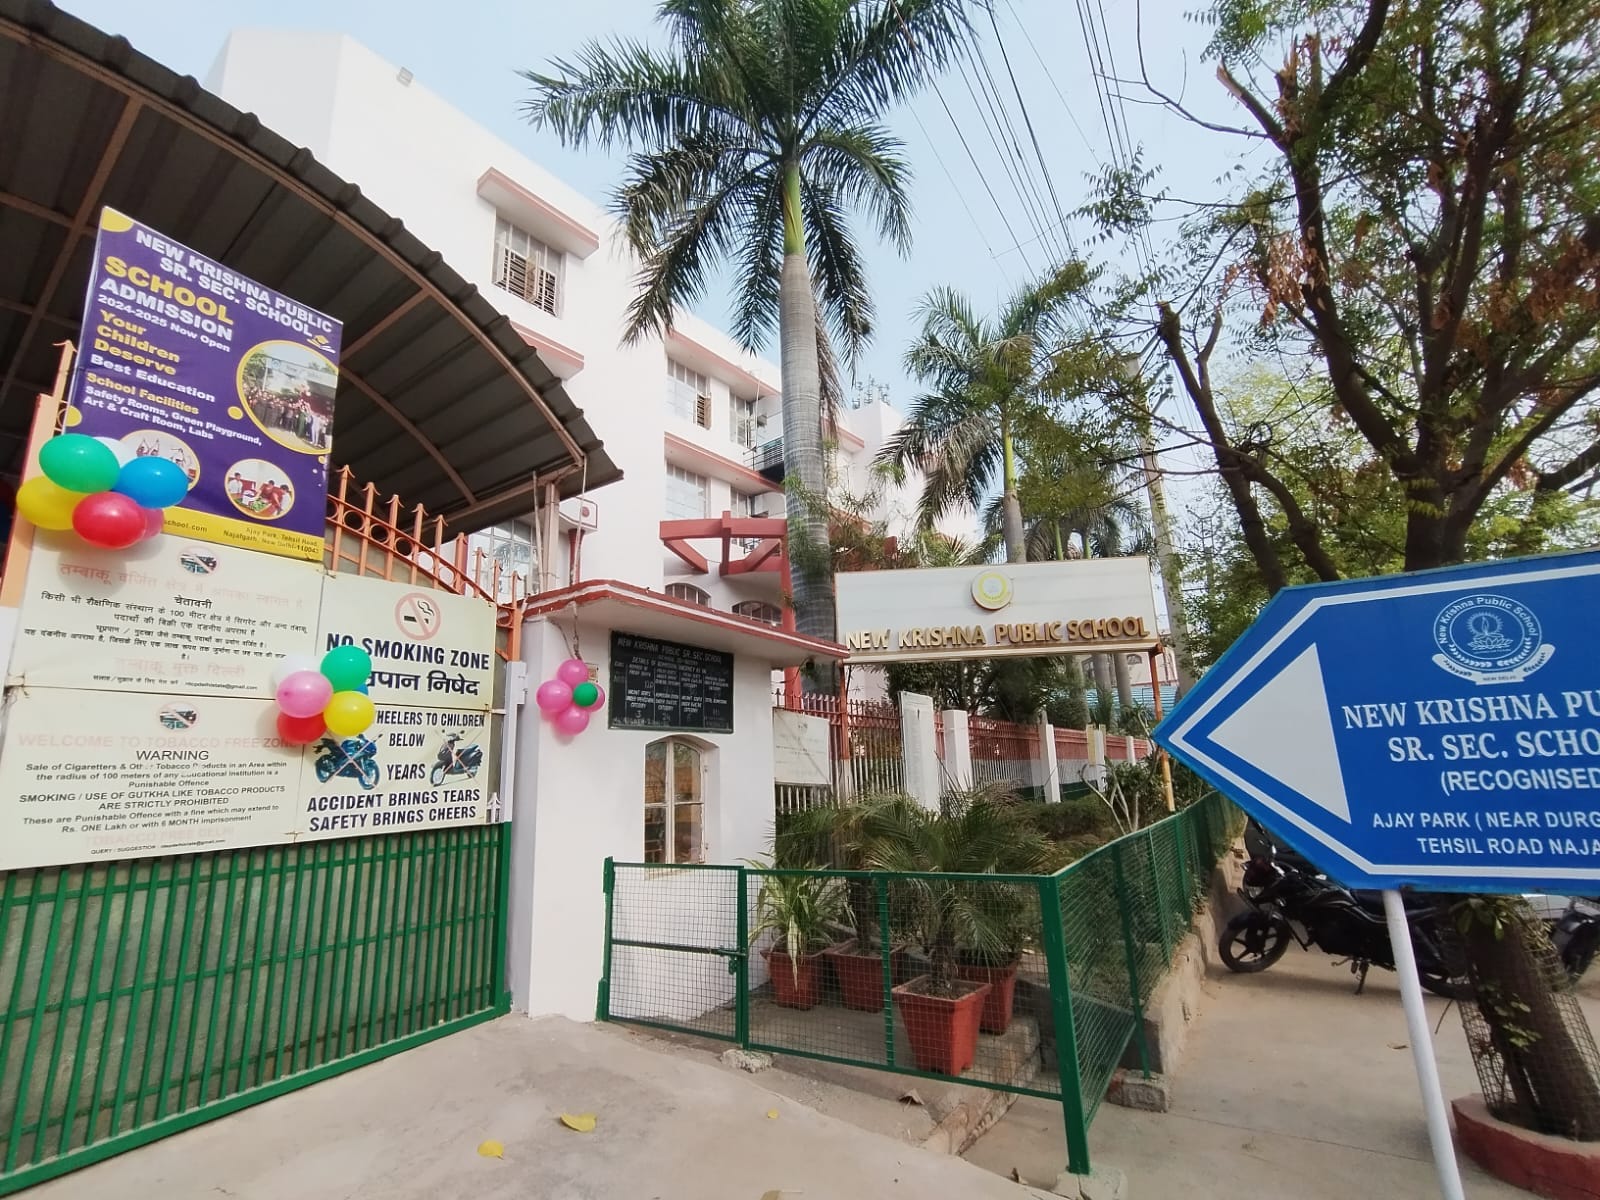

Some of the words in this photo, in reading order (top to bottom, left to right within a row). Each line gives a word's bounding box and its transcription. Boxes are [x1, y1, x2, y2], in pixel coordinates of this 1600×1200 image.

[104, 255, 234, 325] SCHOOL
[136, 230, 184, 260] NEW
[188, 255, 270, 305] KRISHNA
[276, 295, 332, 332] PUBLIC
[100, 278, 233, 341] ADMISSION
[160, 257, 193, 282] SR.
[198, 276, 240, 304] SEC.
[244, 296, 313, 337] SCHOOL
[98, 294, 168, 327] 2024-2025
[170, 322, 198, 339] Now
[201, 336, 231, 353] Open
[100, 309, 147, 335] Your
[96, 324, 180, 362] Children
[94, 338, 176, 376] Deserve
[90, 354, 131, 376] Best
[136, 365, 216, 403] Education
[86, 372, 136, 395] School
[138, 388, 199, 414] Facilities
[83, 396, 104, 410] Art
[107, 402, 116, 412] &
[120, 404, 149, 421] Craft
[152, 414, 187, 433] Room,
[188, 426, 214, 440] Labs
[84, 385, 124, 404] Safety
[127, 397, 168, 418] Rooms,
[171, 411, 204, 428] Green
[205, 420, 262, 446] Playground,
[41, 590, 65, 602] किसी
[71, 594, 81, 604] भी
[170, 609, 184, 617] 100
[174, 594, 212, 609] चेतावनी
[1440, 600, 1474, 624] Krishna
[1476, 597, 1512, 609] Public
[846, 628, 890, 650] NEW
[899, 624, 986, 648] KRISHNA
[994, 620, 1062, 644] PUBLIC
[1067, 616, 1150, 641] SCHOOL
[1513, 606, 1538, 636] School
[1438, 628, 1448, 644] New
[362, 637, 444, 665] SMOKING
[450, 650, 490, 670] ZONE
[376, 710, 423, 726] HEELERS
[426, 713, 438, 726] TO
[441, 714, 485, 727] CHILDREN
[1342, 702, 1407, 729] NEW
[1414, 692, 1558, 726] KRISHNA
[1562, 690, 1600, 718] PU
[18, 734, 113, 748] WELCOME
[120, 736, 140, 748] TO
[146, 737, 220, 748] TOBACCO
[225, 738, 260, 748] FREE
[389, 733, 425, 748] BELOW
[1388, 736, 1434, 762] SR.
[1442, 732, 1509, 760] SEC.
[1515, 727, 1600, 759] SCHO
[26, 763, 48, 771] Sale
[52, 763, 62, 771] of
[64, 763, 117, 772] Cigaretters
[156, 762, 190, 770] Tobacco
[136, 750, 209, 761] WARNING
[387, 764, 426, 782] YEARS
[1441, 767, 1600, 796] (RECOGNISED
[19, 793, 76, 802] SMOKING
[85, 792, 108, 800] USE
[128, 790, 170, 799] GUTKHA
[196, 788, 239, 796] TOBACCO
[241, 785, 286, 794] PRODUCTS
[98, 802, 121, 810] ARE
[124, 800, 171, 809] STRICTLY
[174, 798, 229, 806] PROHIBITED
[307, 793, 383, 813] ACCIDENT
[389, 790, 438, 806] BRINGS
[443, 788, 480, 802] TEARS
[23, 817, 53, 825] These
[75, 813, 127, 822] Punishable
[129, 811, 164, 819] Offence
[208, 807, 229, 815] which
[81, 824, 102, 832] ONE
[104, 823, 127, 831] Lakh
[168, 818, 199, 826] MONTH
[201, 815, 252, 824] imprisonment
[308, 813, 368, 832] SAFETY
[372, 809, 424, 827] BRINGS
[428, 806, 476, 822] CHEERS
[1373, 813, 1414, 828] AJAY
[1420, 812, 1470, 828] PARK
[1487, 811, 1540, 828] NEAR
[1545, 811, 1600, 828] DURG
[1417, 837, 1483, 854] TEHSIL
[1488, 838, 1543, 854] ROAD
